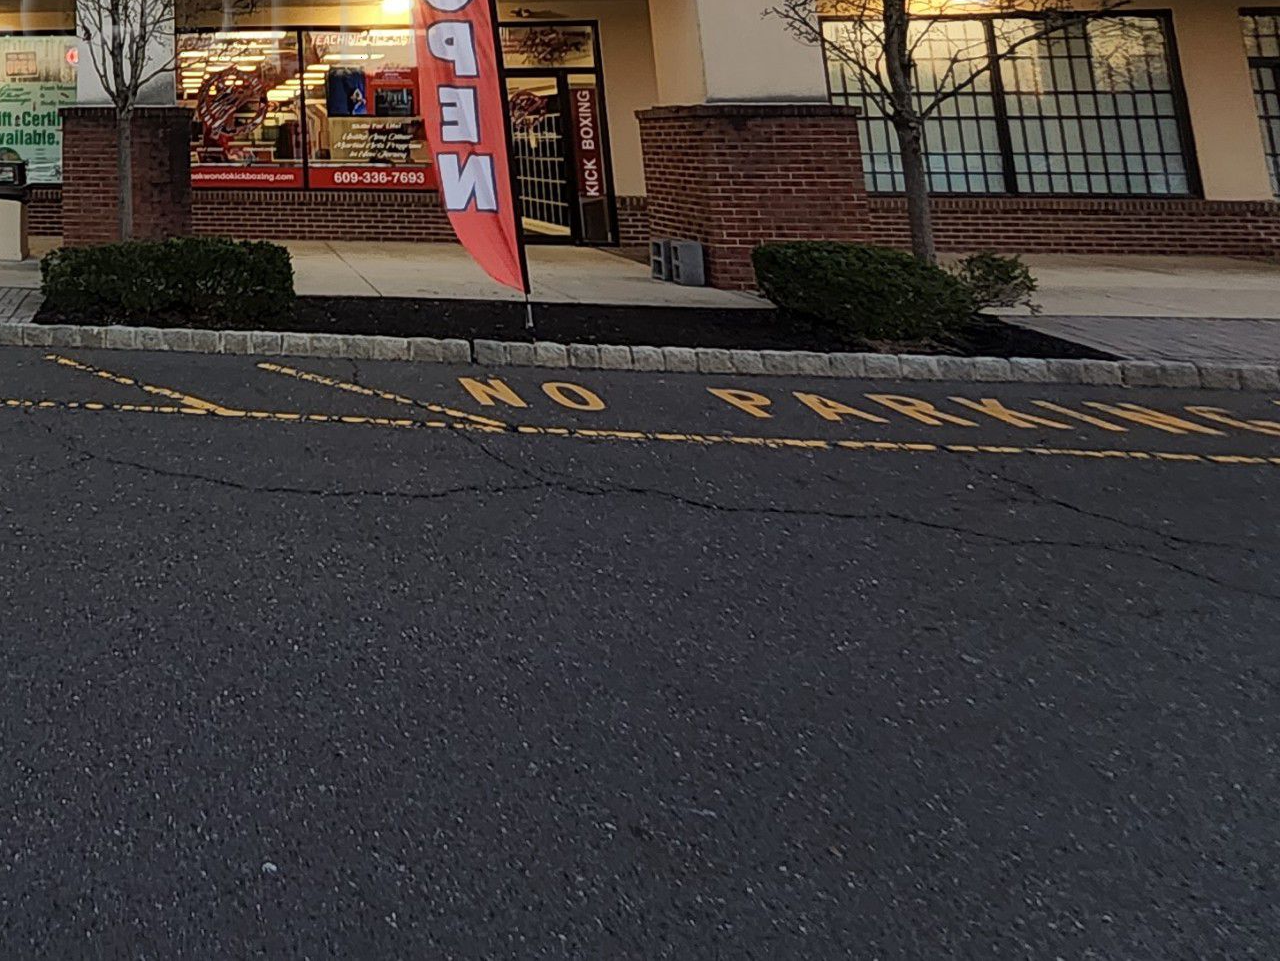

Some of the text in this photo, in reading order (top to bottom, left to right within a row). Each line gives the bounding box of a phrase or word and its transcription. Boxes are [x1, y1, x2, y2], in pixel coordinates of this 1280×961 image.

[576, 89, 600, 197] KICK BOXING
[333, 171, 426, 184] 609-336-7693
[457, 376, 607, 411] NO
